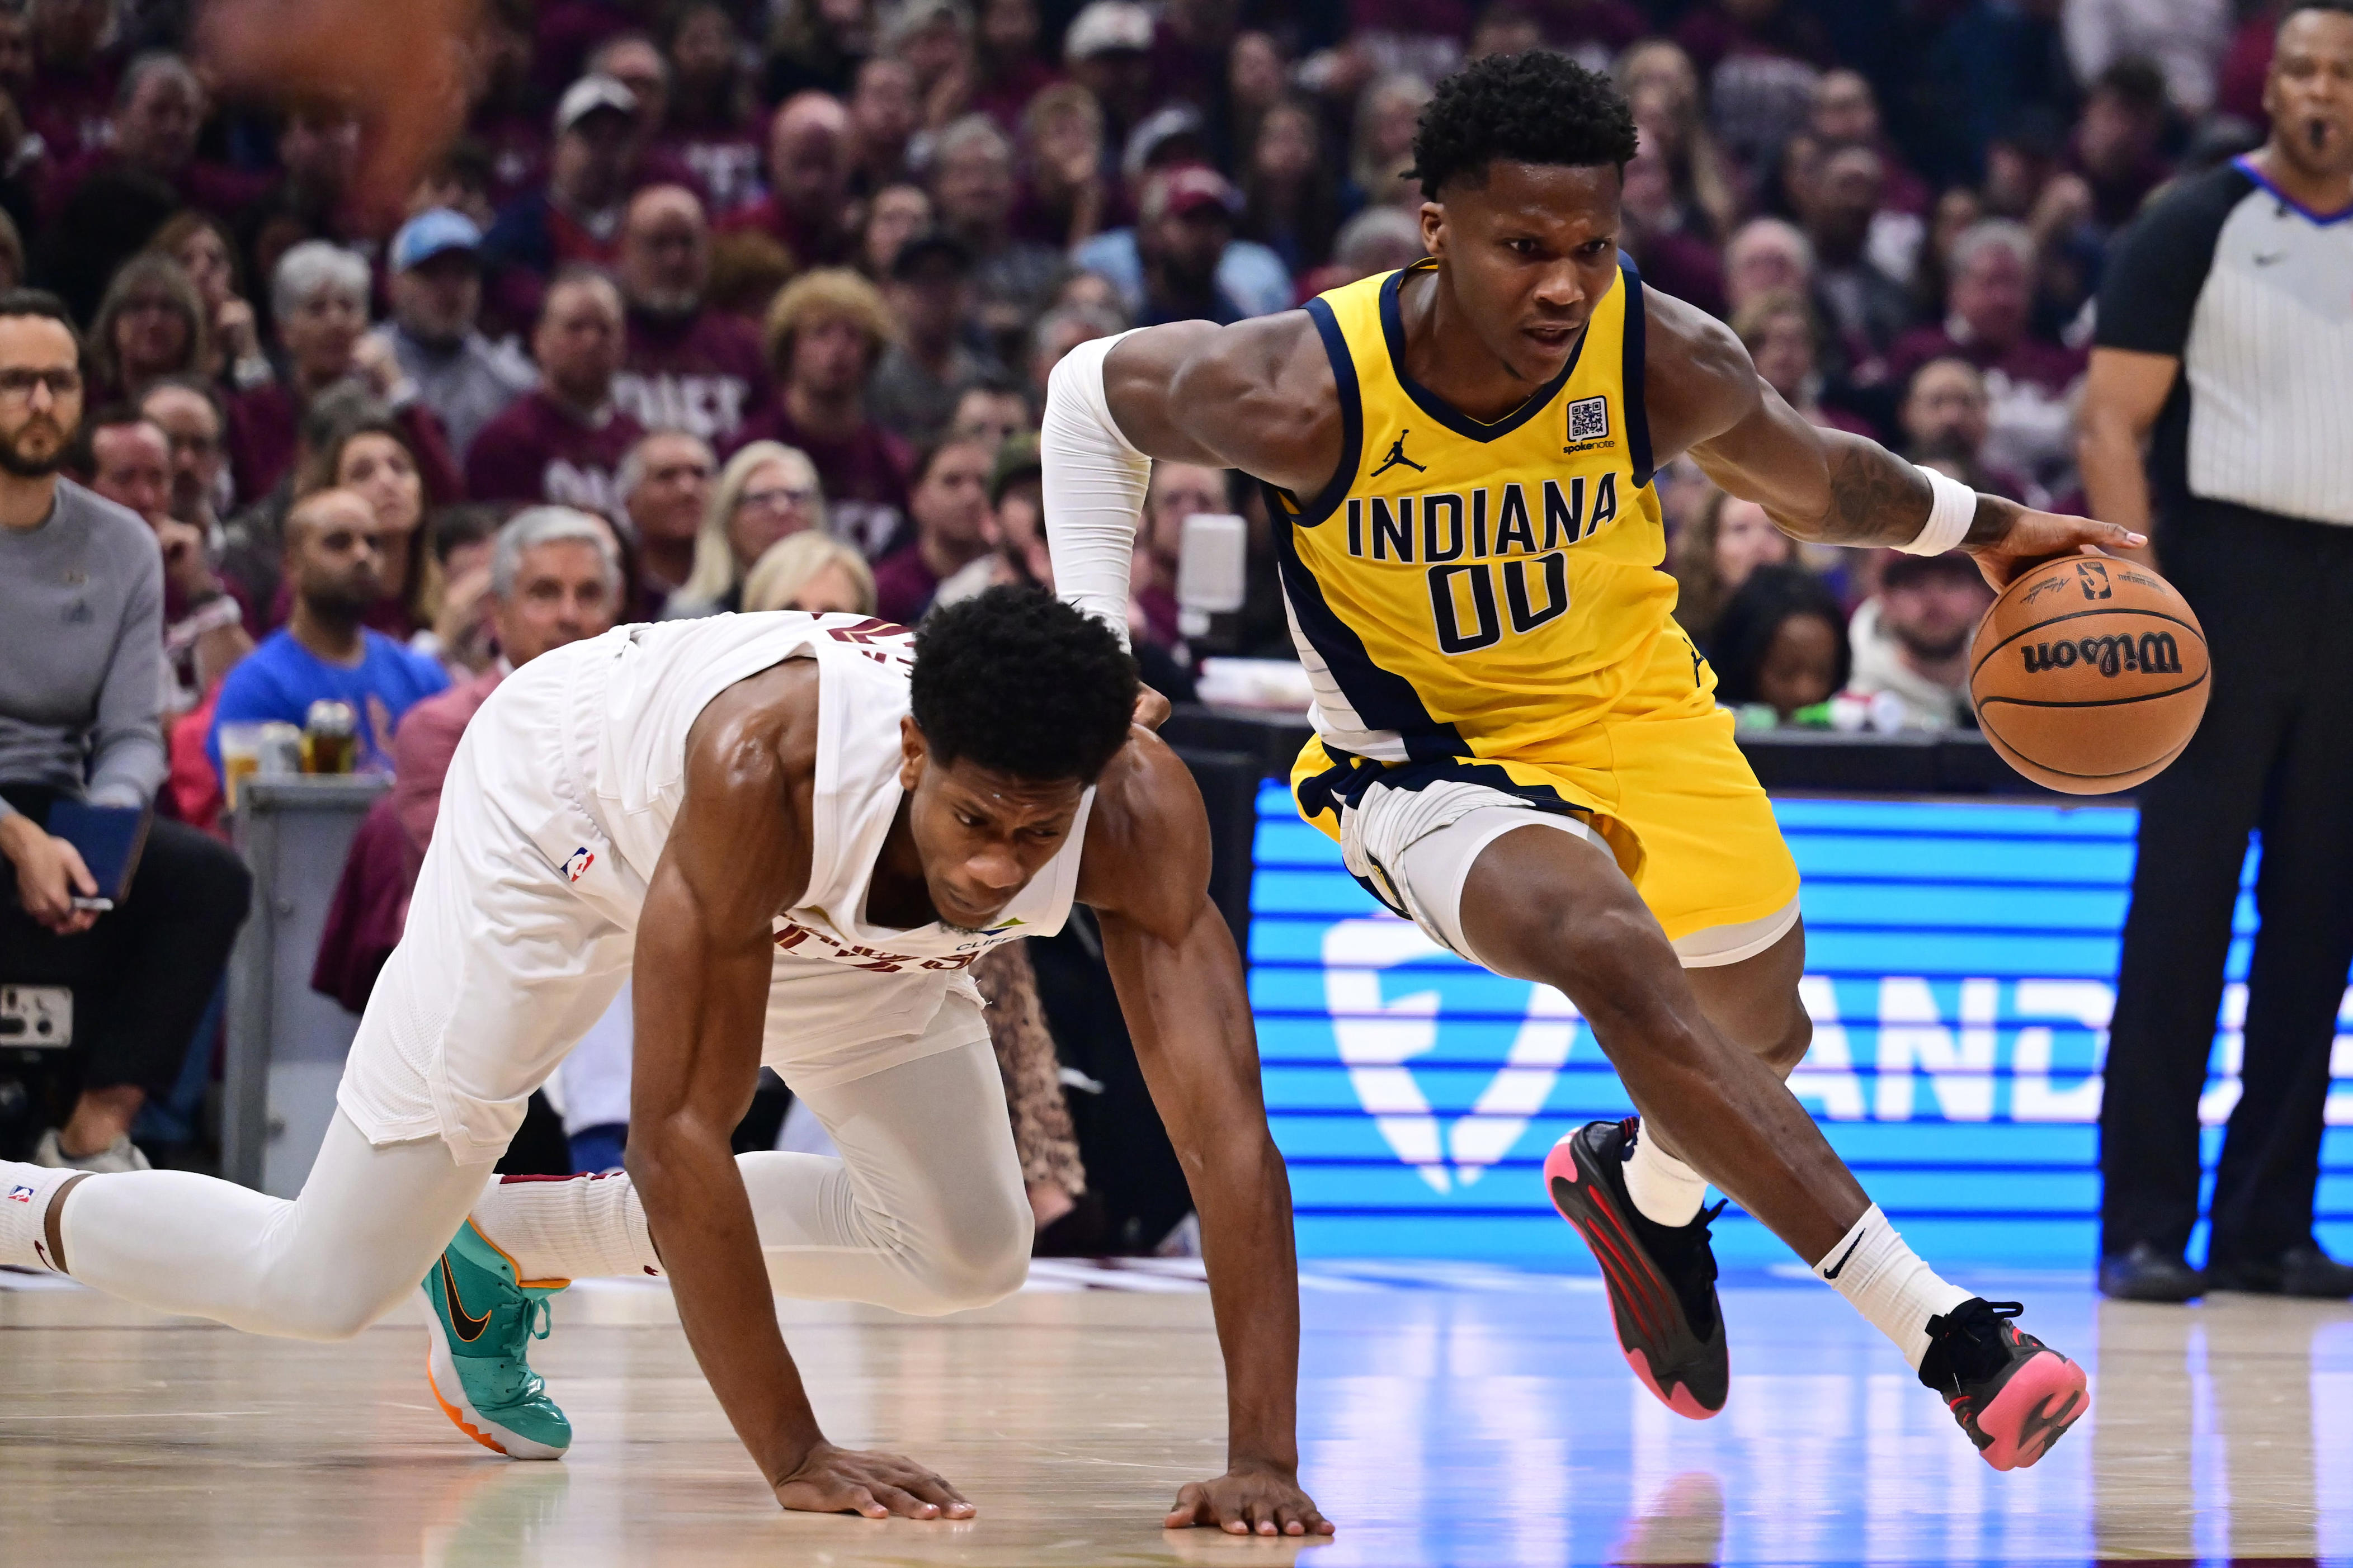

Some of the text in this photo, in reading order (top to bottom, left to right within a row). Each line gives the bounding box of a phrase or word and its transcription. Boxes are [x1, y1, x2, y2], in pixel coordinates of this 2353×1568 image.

[1563, 441, 1615, 455] spokenote
[1346, 472, 1619, 564] INDIANA
[1426, 550, 1571, 657] 00
[2021, 631, 2182, 678] Wilson
